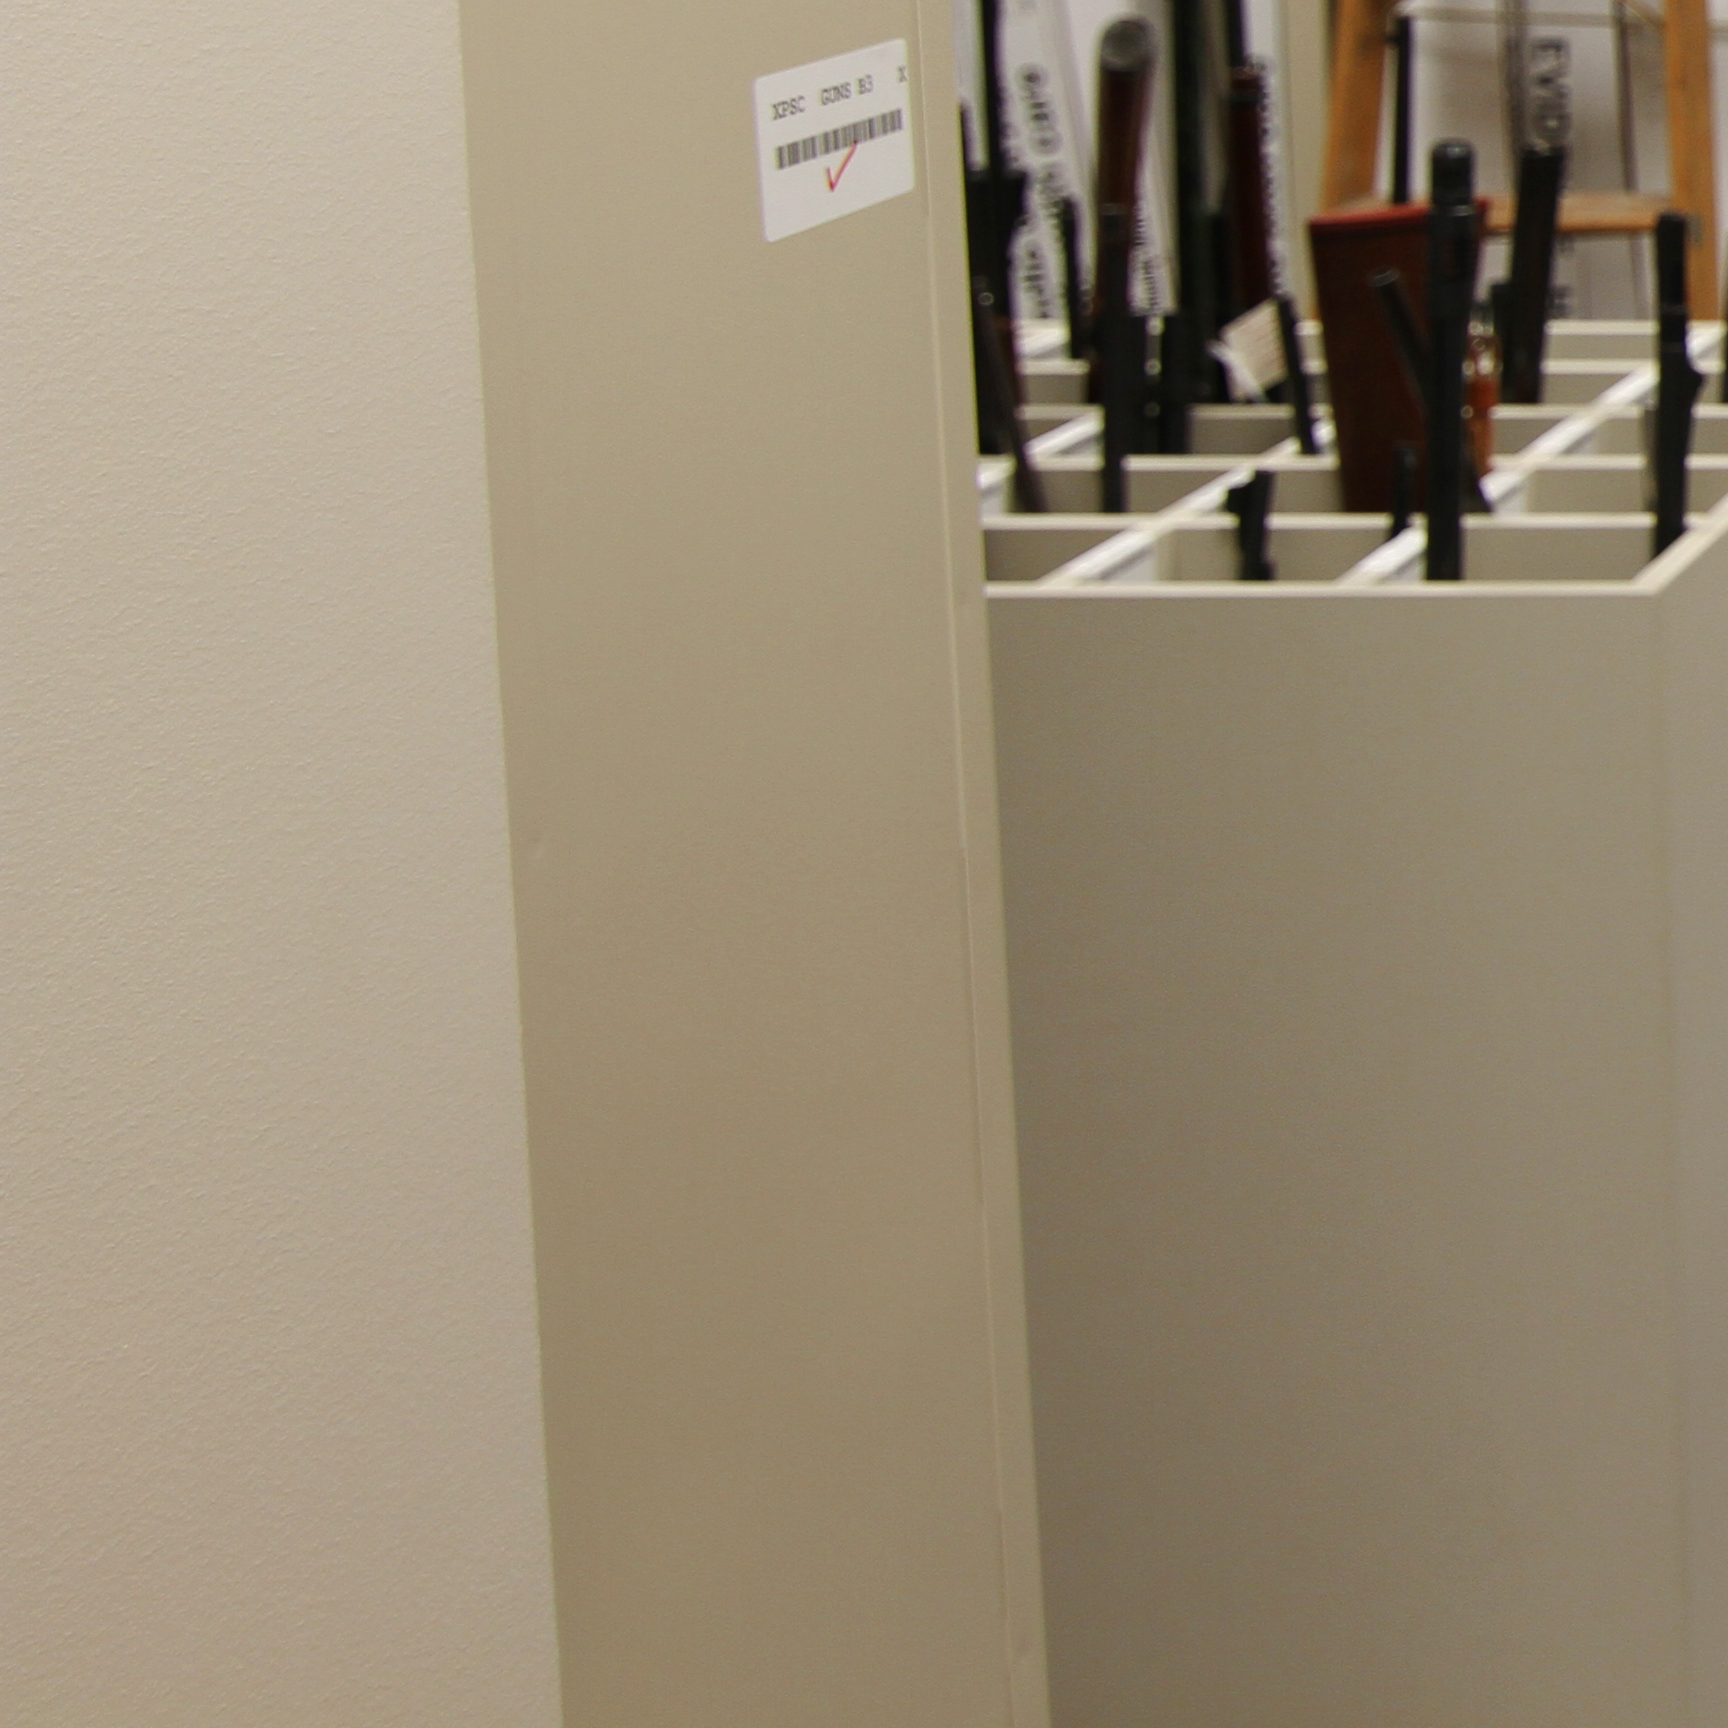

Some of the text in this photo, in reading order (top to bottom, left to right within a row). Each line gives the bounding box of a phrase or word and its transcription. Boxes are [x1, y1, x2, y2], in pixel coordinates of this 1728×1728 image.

[772, 95, 805, 121] XPSC
[821, 82, 851, 106] GUNS
[858, 75, 874, 95] B3
